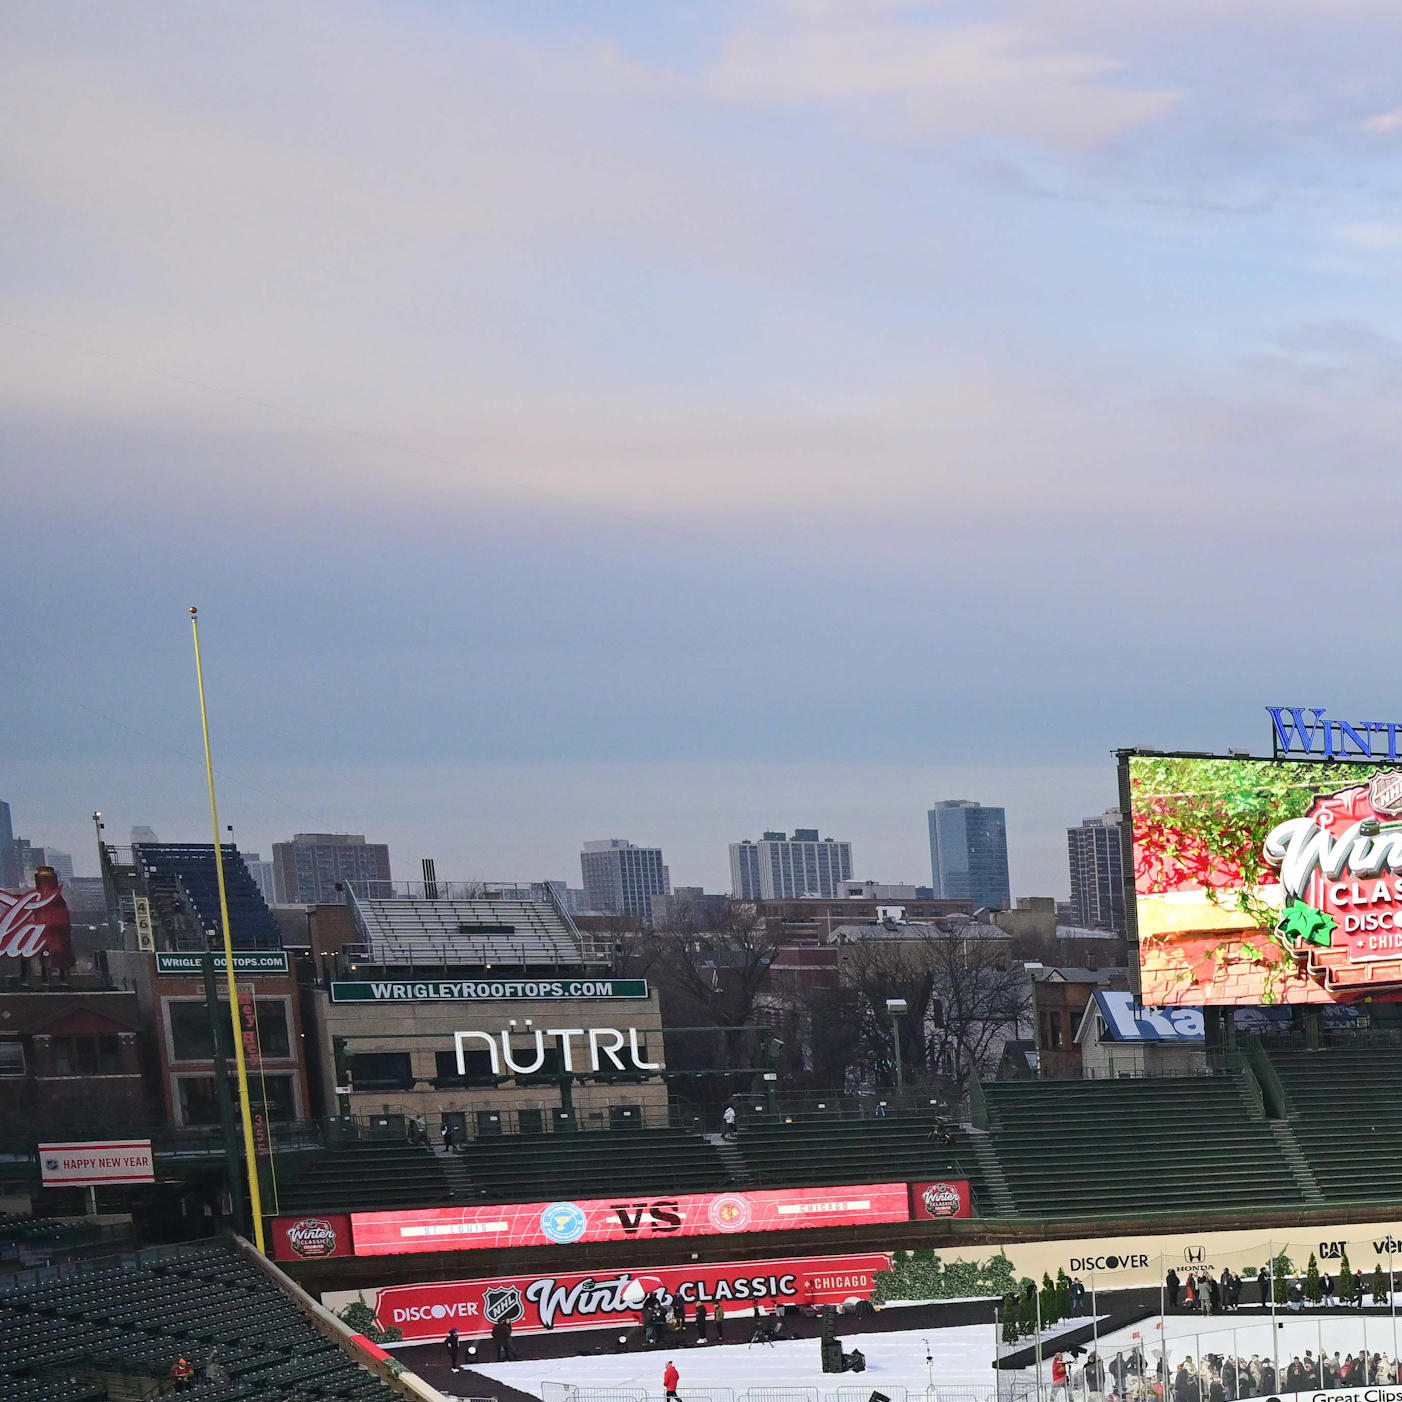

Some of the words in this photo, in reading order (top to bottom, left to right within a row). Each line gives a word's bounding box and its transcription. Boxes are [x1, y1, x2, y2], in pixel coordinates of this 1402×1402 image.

[63, 1158, 97, 1171] HAPPY
[99, 1158, 122, 1169] NEW
[124, 1157, 149, 1168] YEAR
[611, 1201, 682, 1234] VS
[1320, 1241, 1347, 1259] CAT
[1071, 1254, 1149, 1271] DISCOVER
[1176, 1264, 1215, 1273] HONDA
[394, 1302, 478, 1323] DISCOVER
[492, 1293, 517, 1319] NHL
[680, 1274, 797, 1302] CLASSIC
[814, 1275, 868, 1290] CHICAGO
